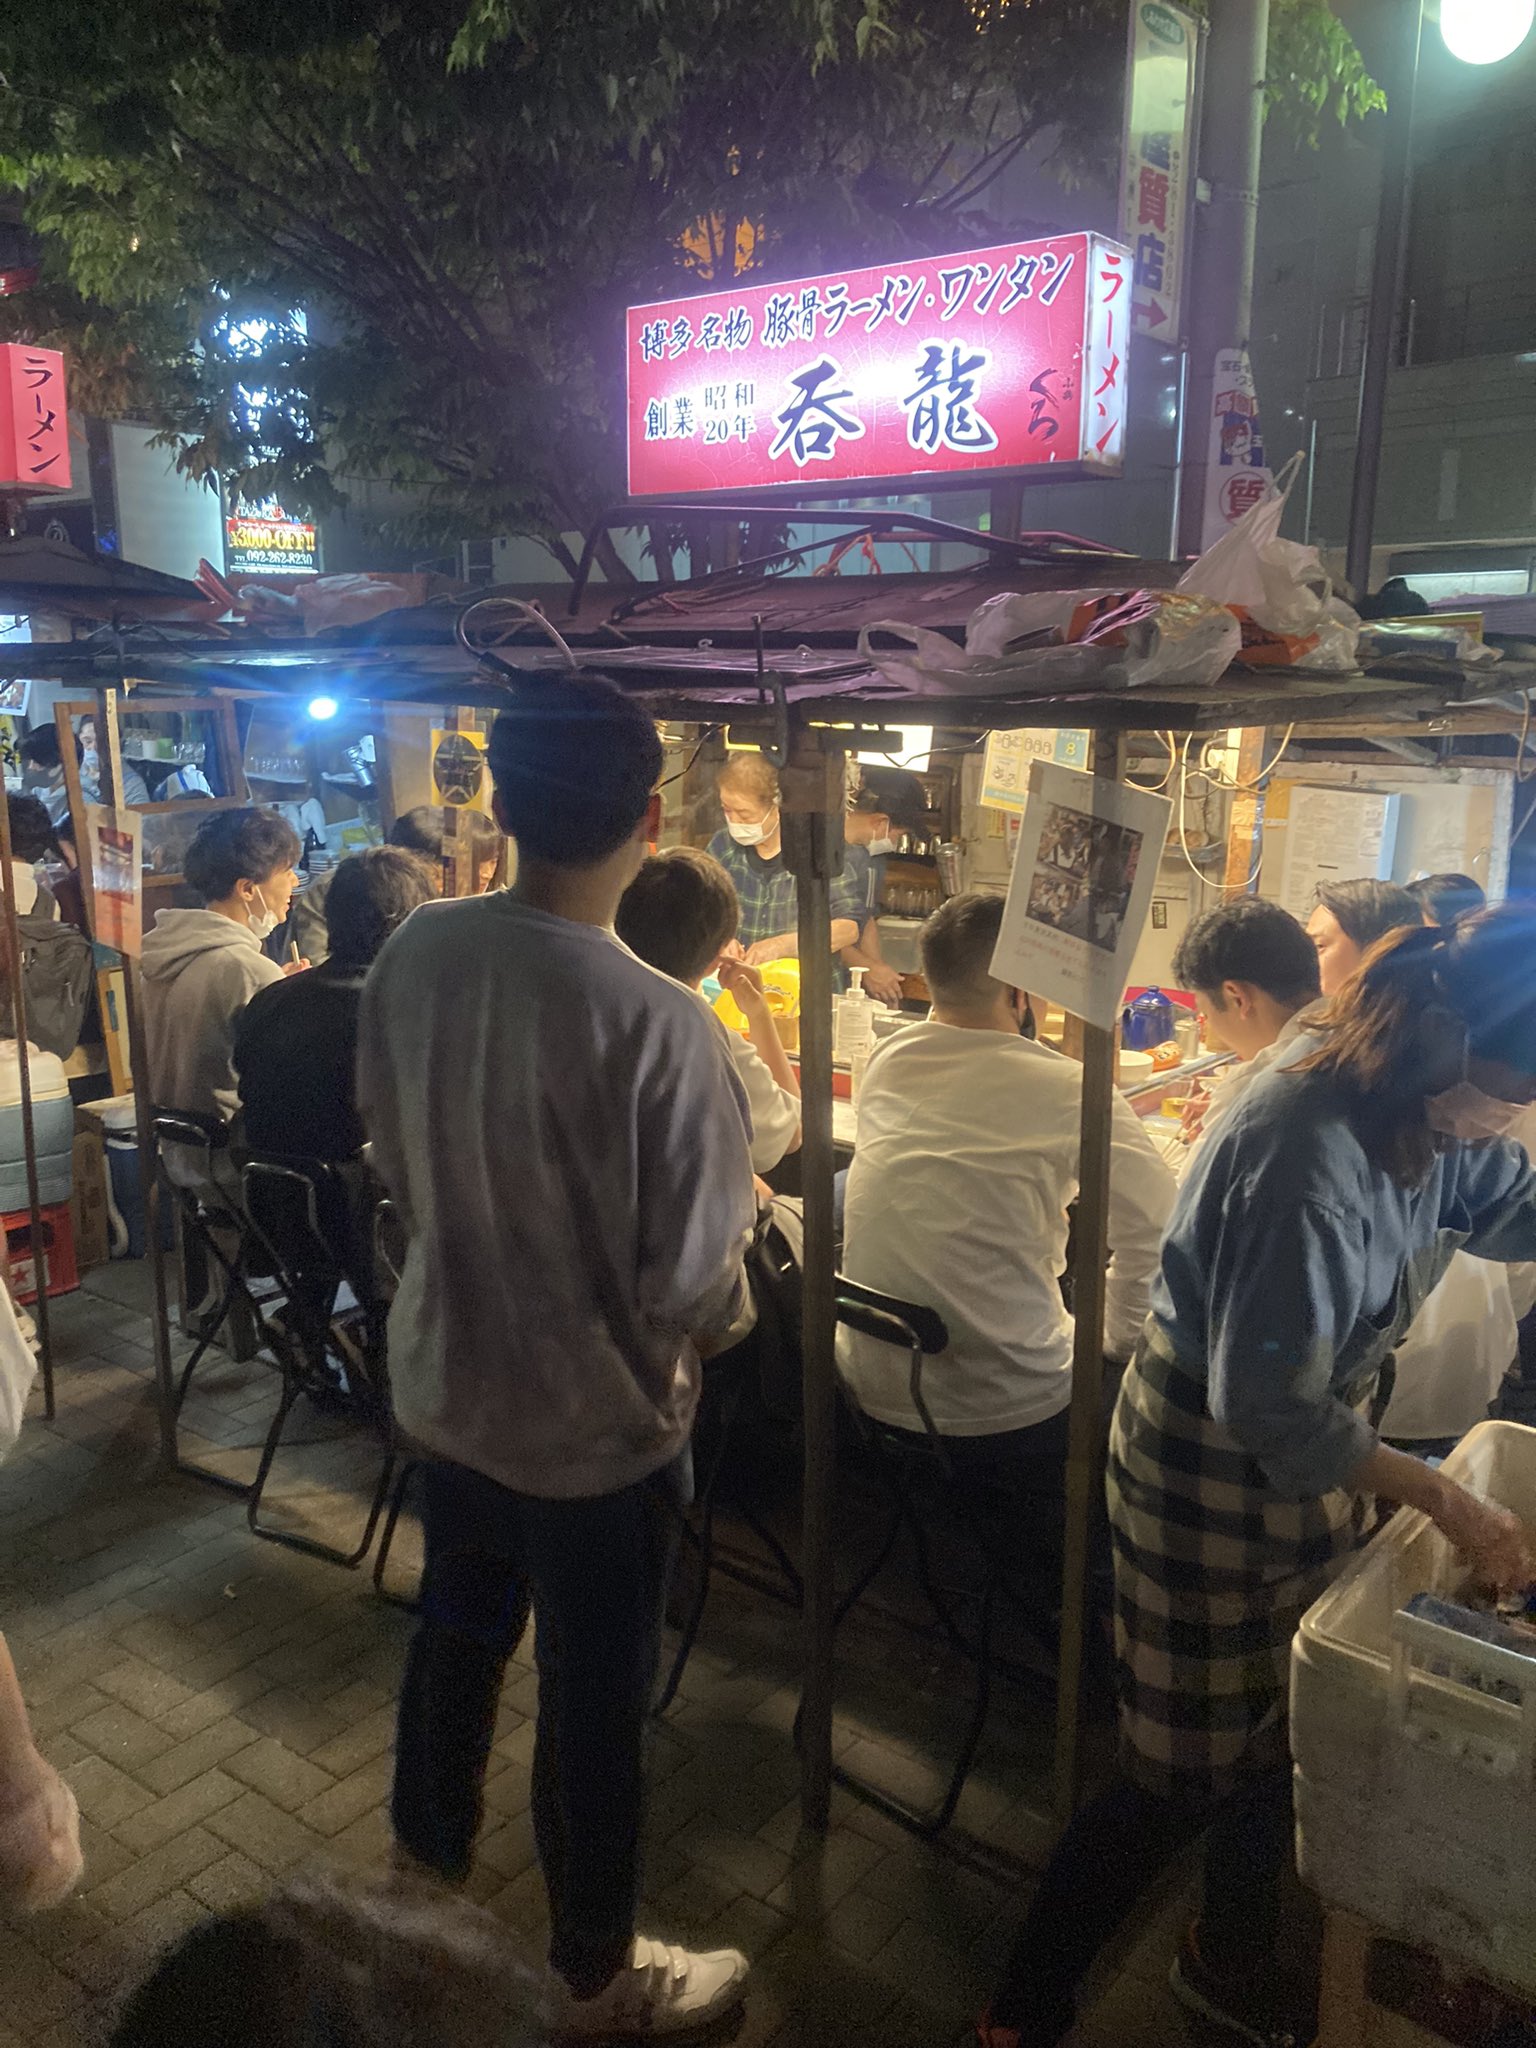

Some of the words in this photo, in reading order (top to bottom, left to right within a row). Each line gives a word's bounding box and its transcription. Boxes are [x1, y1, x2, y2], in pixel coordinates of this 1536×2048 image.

[641, 308, 752, 360] 博多名物
[763, 252, 1075, 343] 豚骨ラーメン・ワンタン
[1094, 252, 1124, 454] ラーメン
[21, 356, 62, 474] ラーメン
[647, 396, 694, 439] 創業
[704, 381, 755, 411] 昭和
[705, 415, 755, 441] 20年
[774, 345, 995, 461] 呑龍
